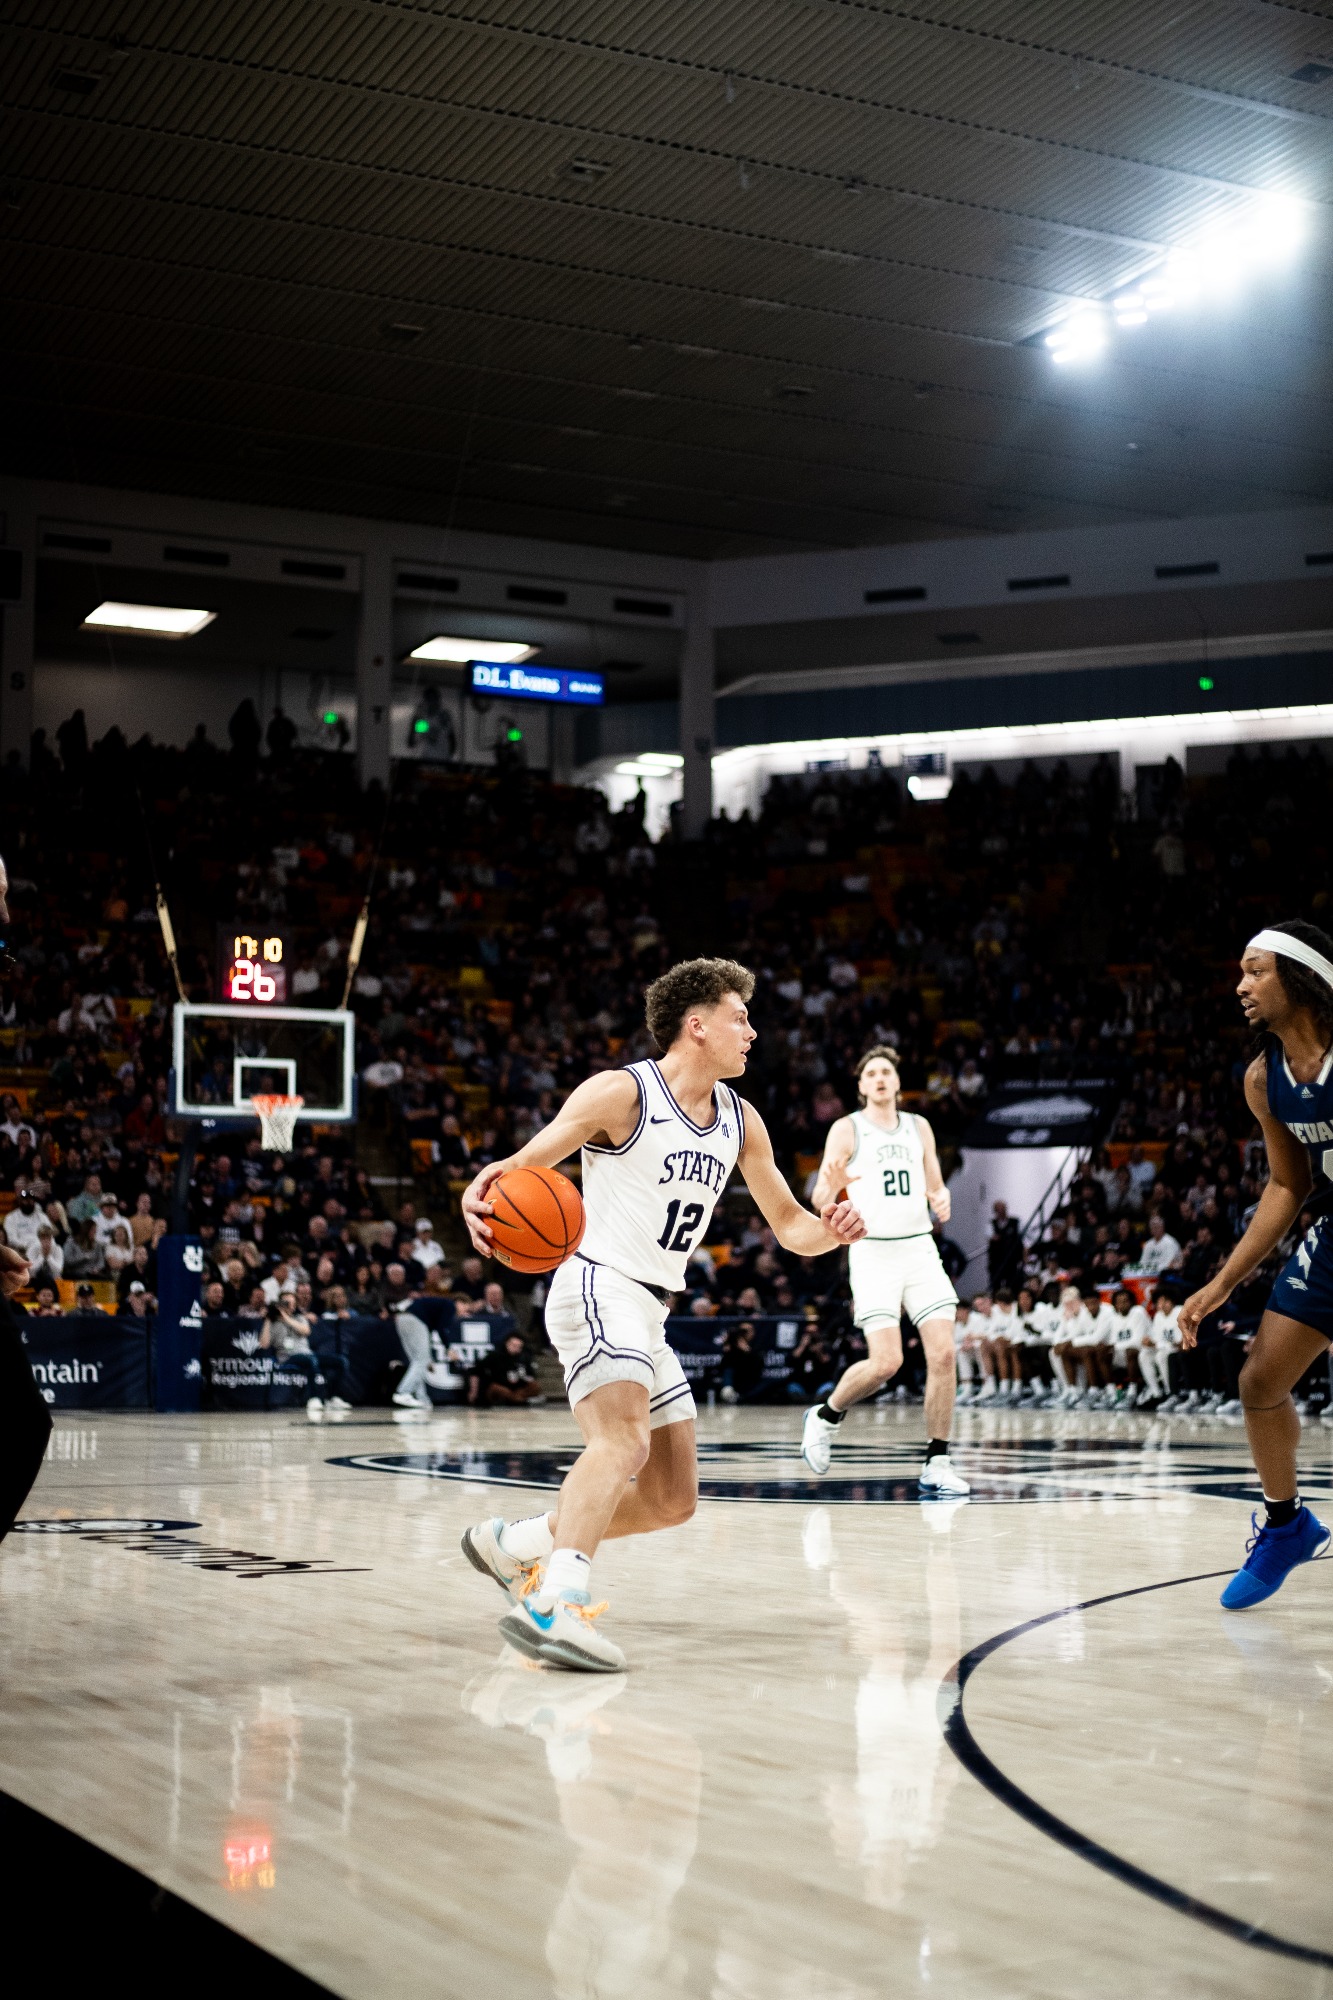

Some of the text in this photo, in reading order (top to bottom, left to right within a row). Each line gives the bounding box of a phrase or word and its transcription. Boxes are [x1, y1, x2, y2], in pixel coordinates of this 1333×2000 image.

[230, 959, 276, 1001] 26
[657, 1149, 727, 1196] STATE
[883, 1169, 911, 1197] 20
[656, 1198, 705, 1253] 12
